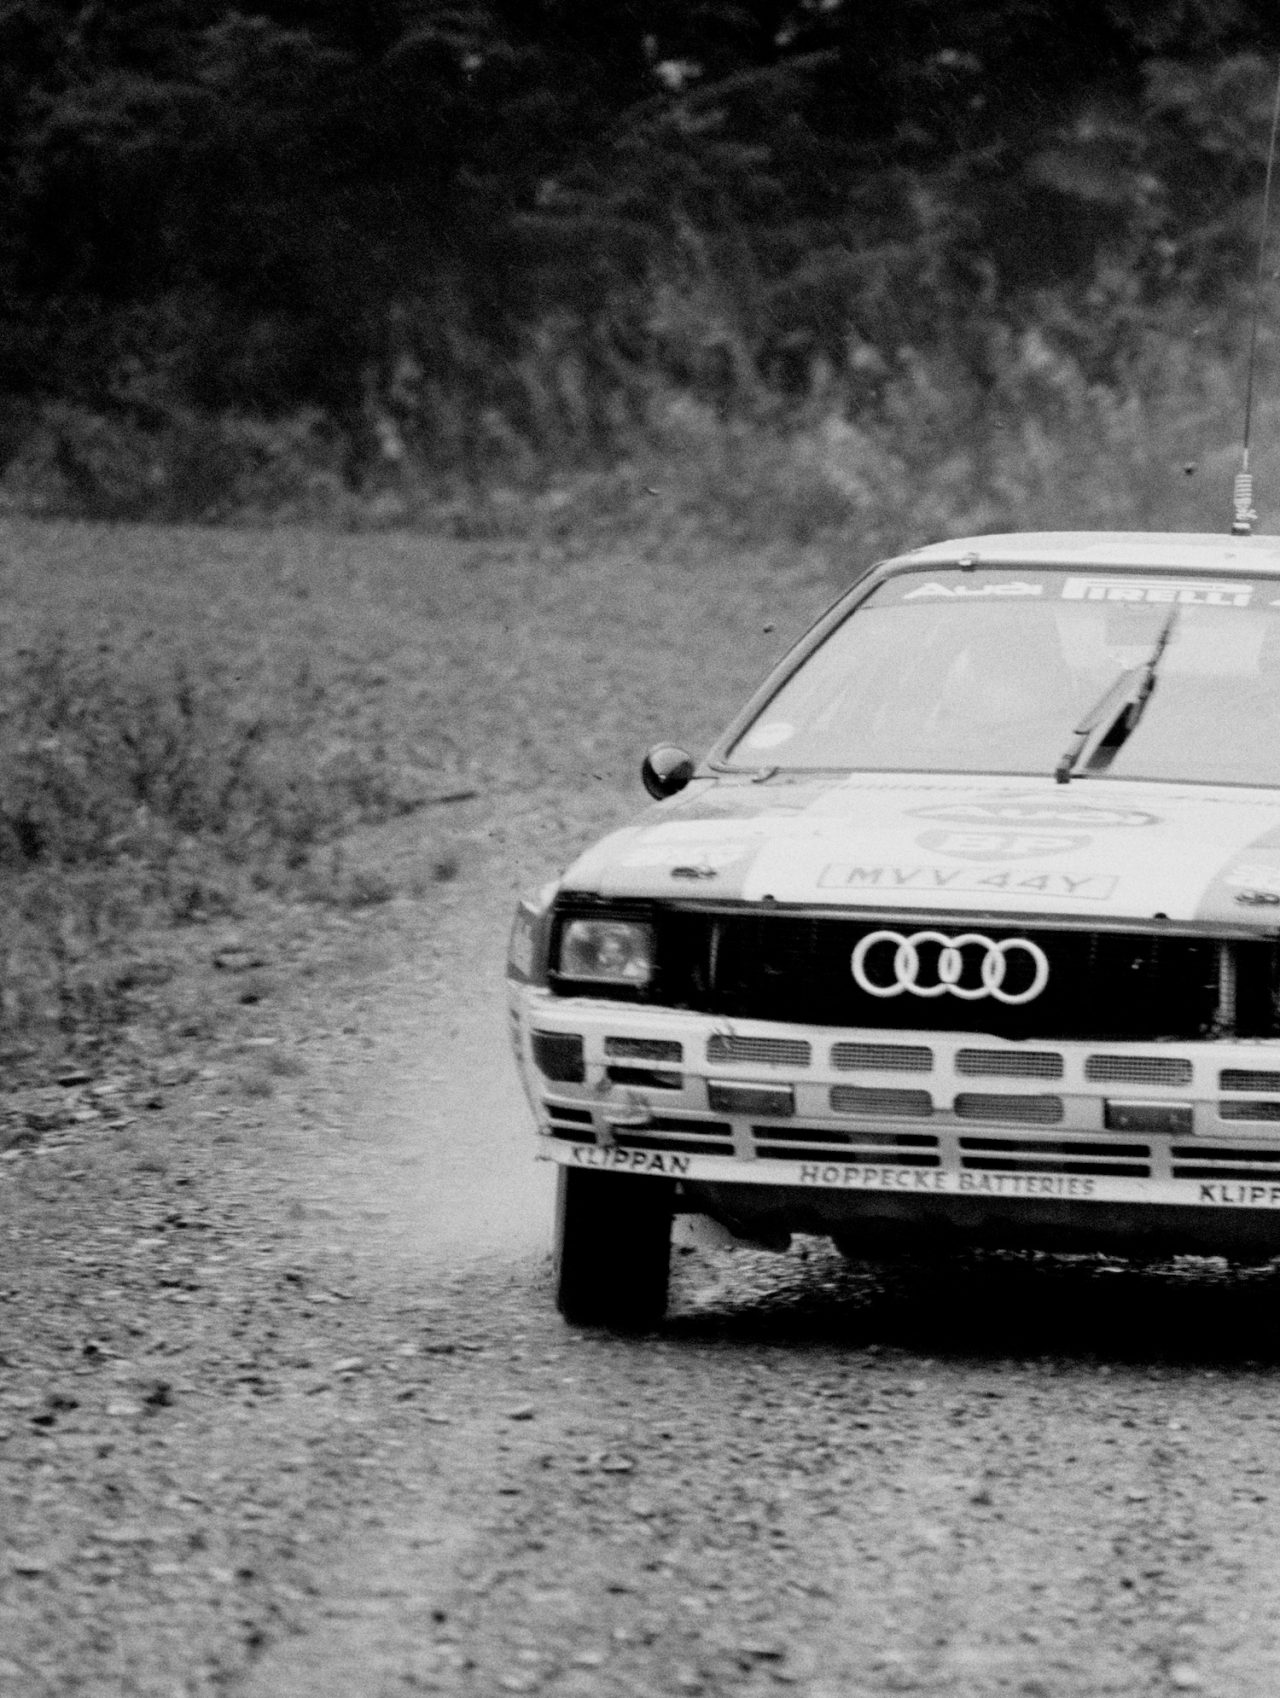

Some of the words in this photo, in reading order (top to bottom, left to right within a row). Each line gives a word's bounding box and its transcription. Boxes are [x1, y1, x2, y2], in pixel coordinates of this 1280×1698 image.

[846, 866, 963, 889] MVV
[976, 870, 1095, 893] 44Y
[570, 1146, 692, 1175] KLIPPAN
[799, 1163, 947, 1191] HOPPECKE
[957, 1172, 1096, 1198] BATTERIES
